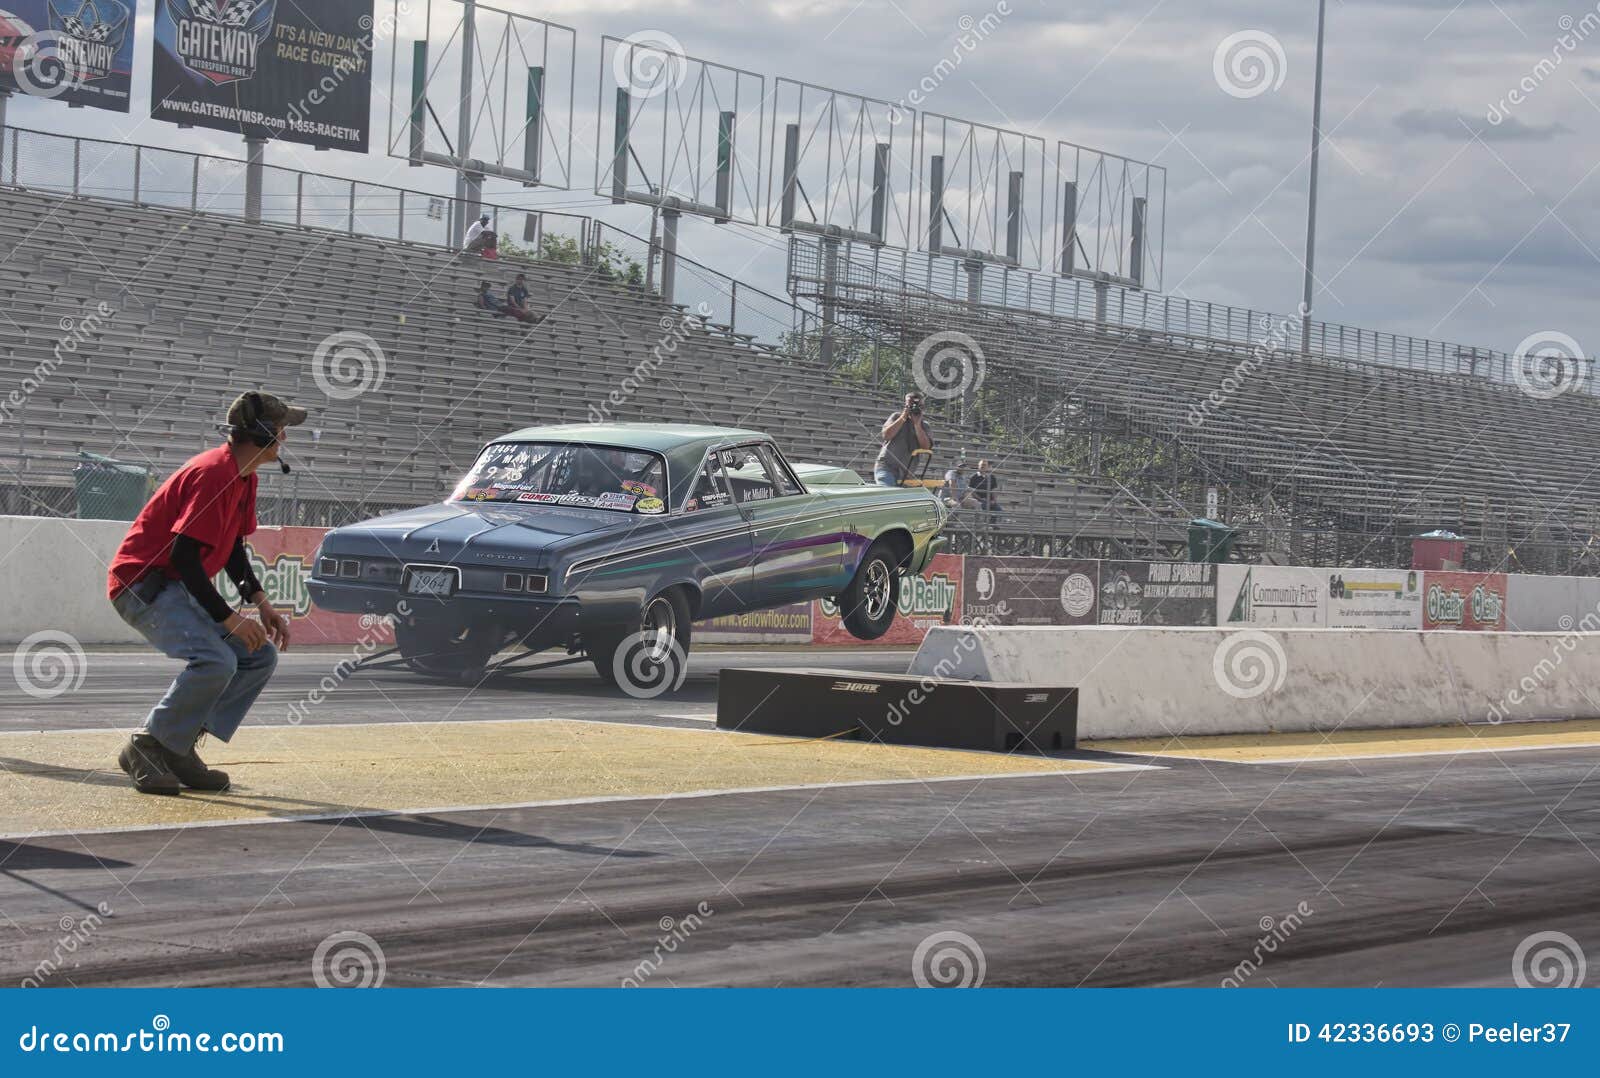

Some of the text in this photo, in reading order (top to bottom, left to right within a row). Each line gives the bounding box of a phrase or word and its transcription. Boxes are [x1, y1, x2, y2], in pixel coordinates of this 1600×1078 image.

[179, 18, 259, 69] GATEWAY
[275, 23, 297, 41] IT'S
[298, 29, 306, 44] A
[309, 30, 336, 48] NEW
[57, 36, 114, 71] GATEWAY
[277, 43, 309, 62] RACE
[162, 99, 361, 142] www.GATEWAYMSP.com 1-855-RACETIK
[1252, 582, 1299, 605] Community
[1300, 584, 1318, 603] First
